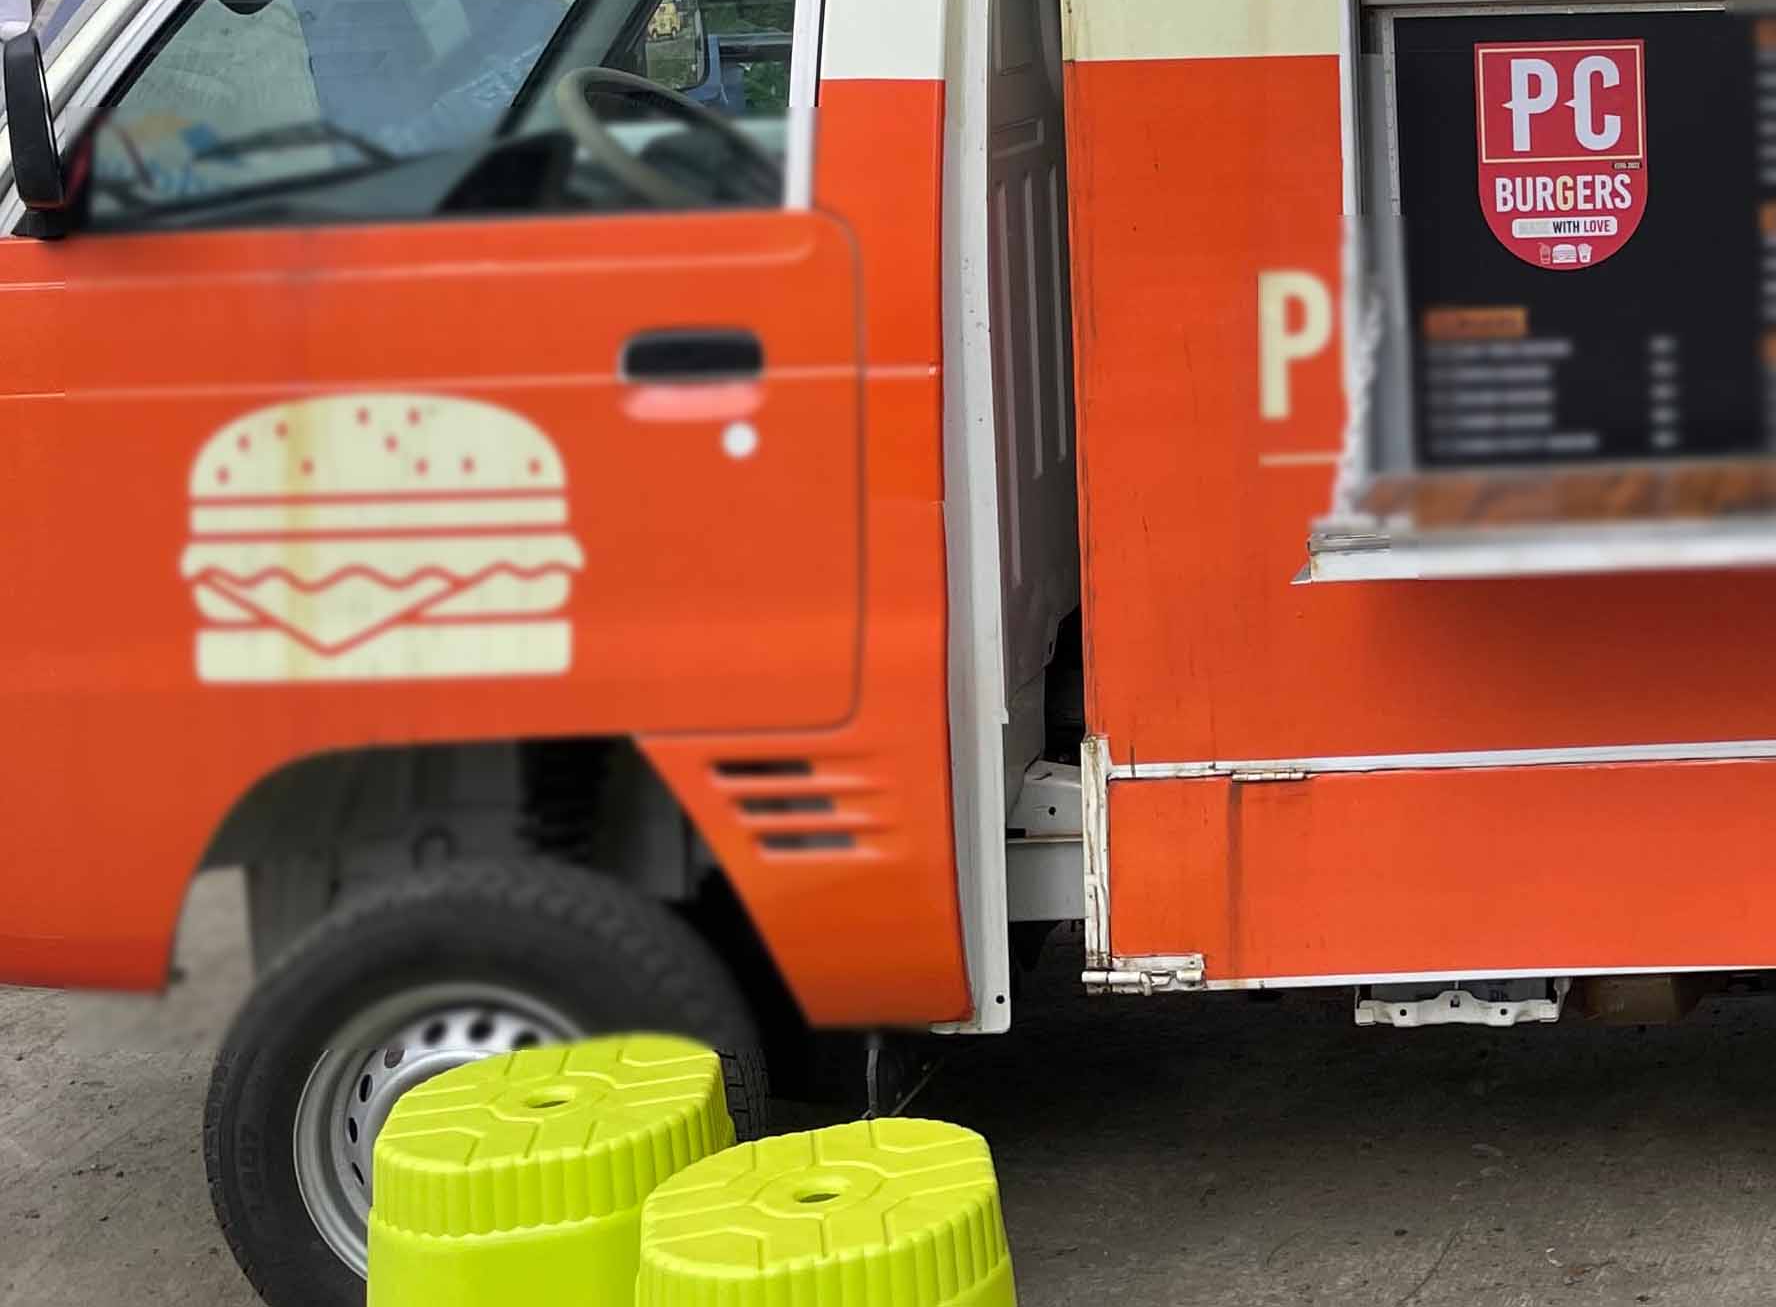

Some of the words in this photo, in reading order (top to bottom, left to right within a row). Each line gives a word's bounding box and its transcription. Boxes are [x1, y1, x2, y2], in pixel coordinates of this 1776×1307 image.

[1502, 55, 1621, 152] PC
[1495, 173, 1633, 213] BURGERS
[1552, 219, 1580, 234] WITH
[1583, 219, 1611, 233] LOVE
